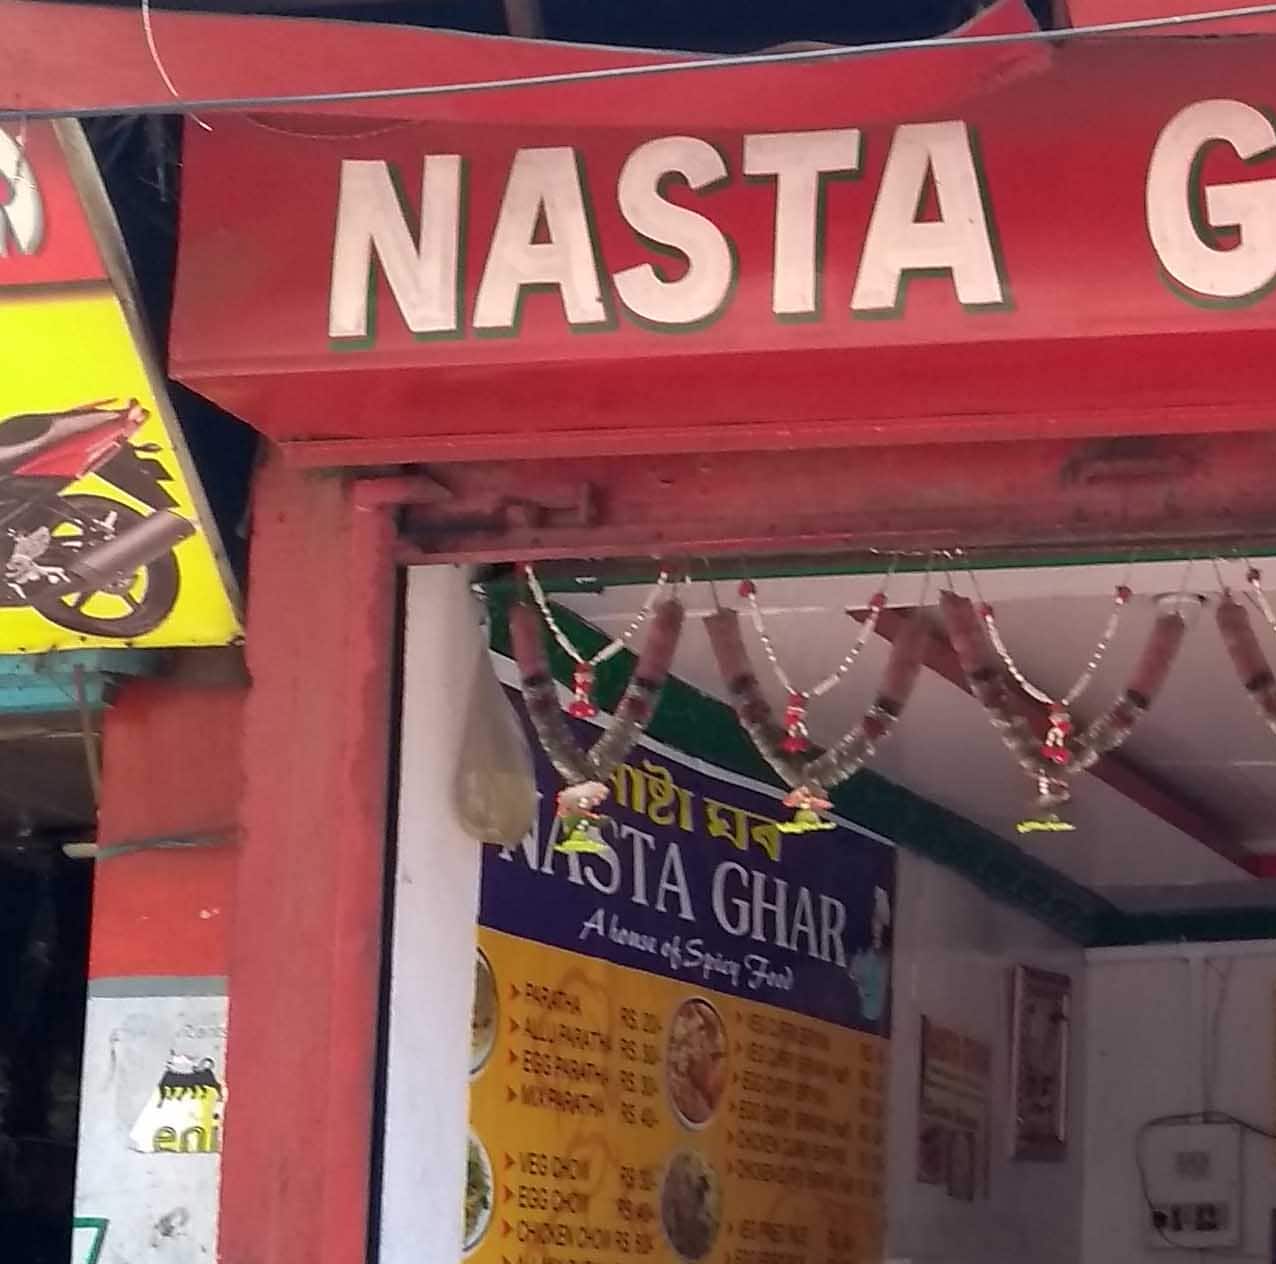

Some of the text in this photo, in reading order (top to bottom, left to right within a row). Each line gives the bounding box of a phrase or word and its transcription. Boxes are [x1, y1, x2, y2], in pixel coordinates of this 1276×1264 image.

[329, 118, 1008, 342] NASTA
[578, 907, 605, 940] A
[682, 938, 741, 987] Spicy
[743, 953, 795, 990] Food
[711, 861, 848, 968] GHAR
[154, 1113, 219, 1152] eni
